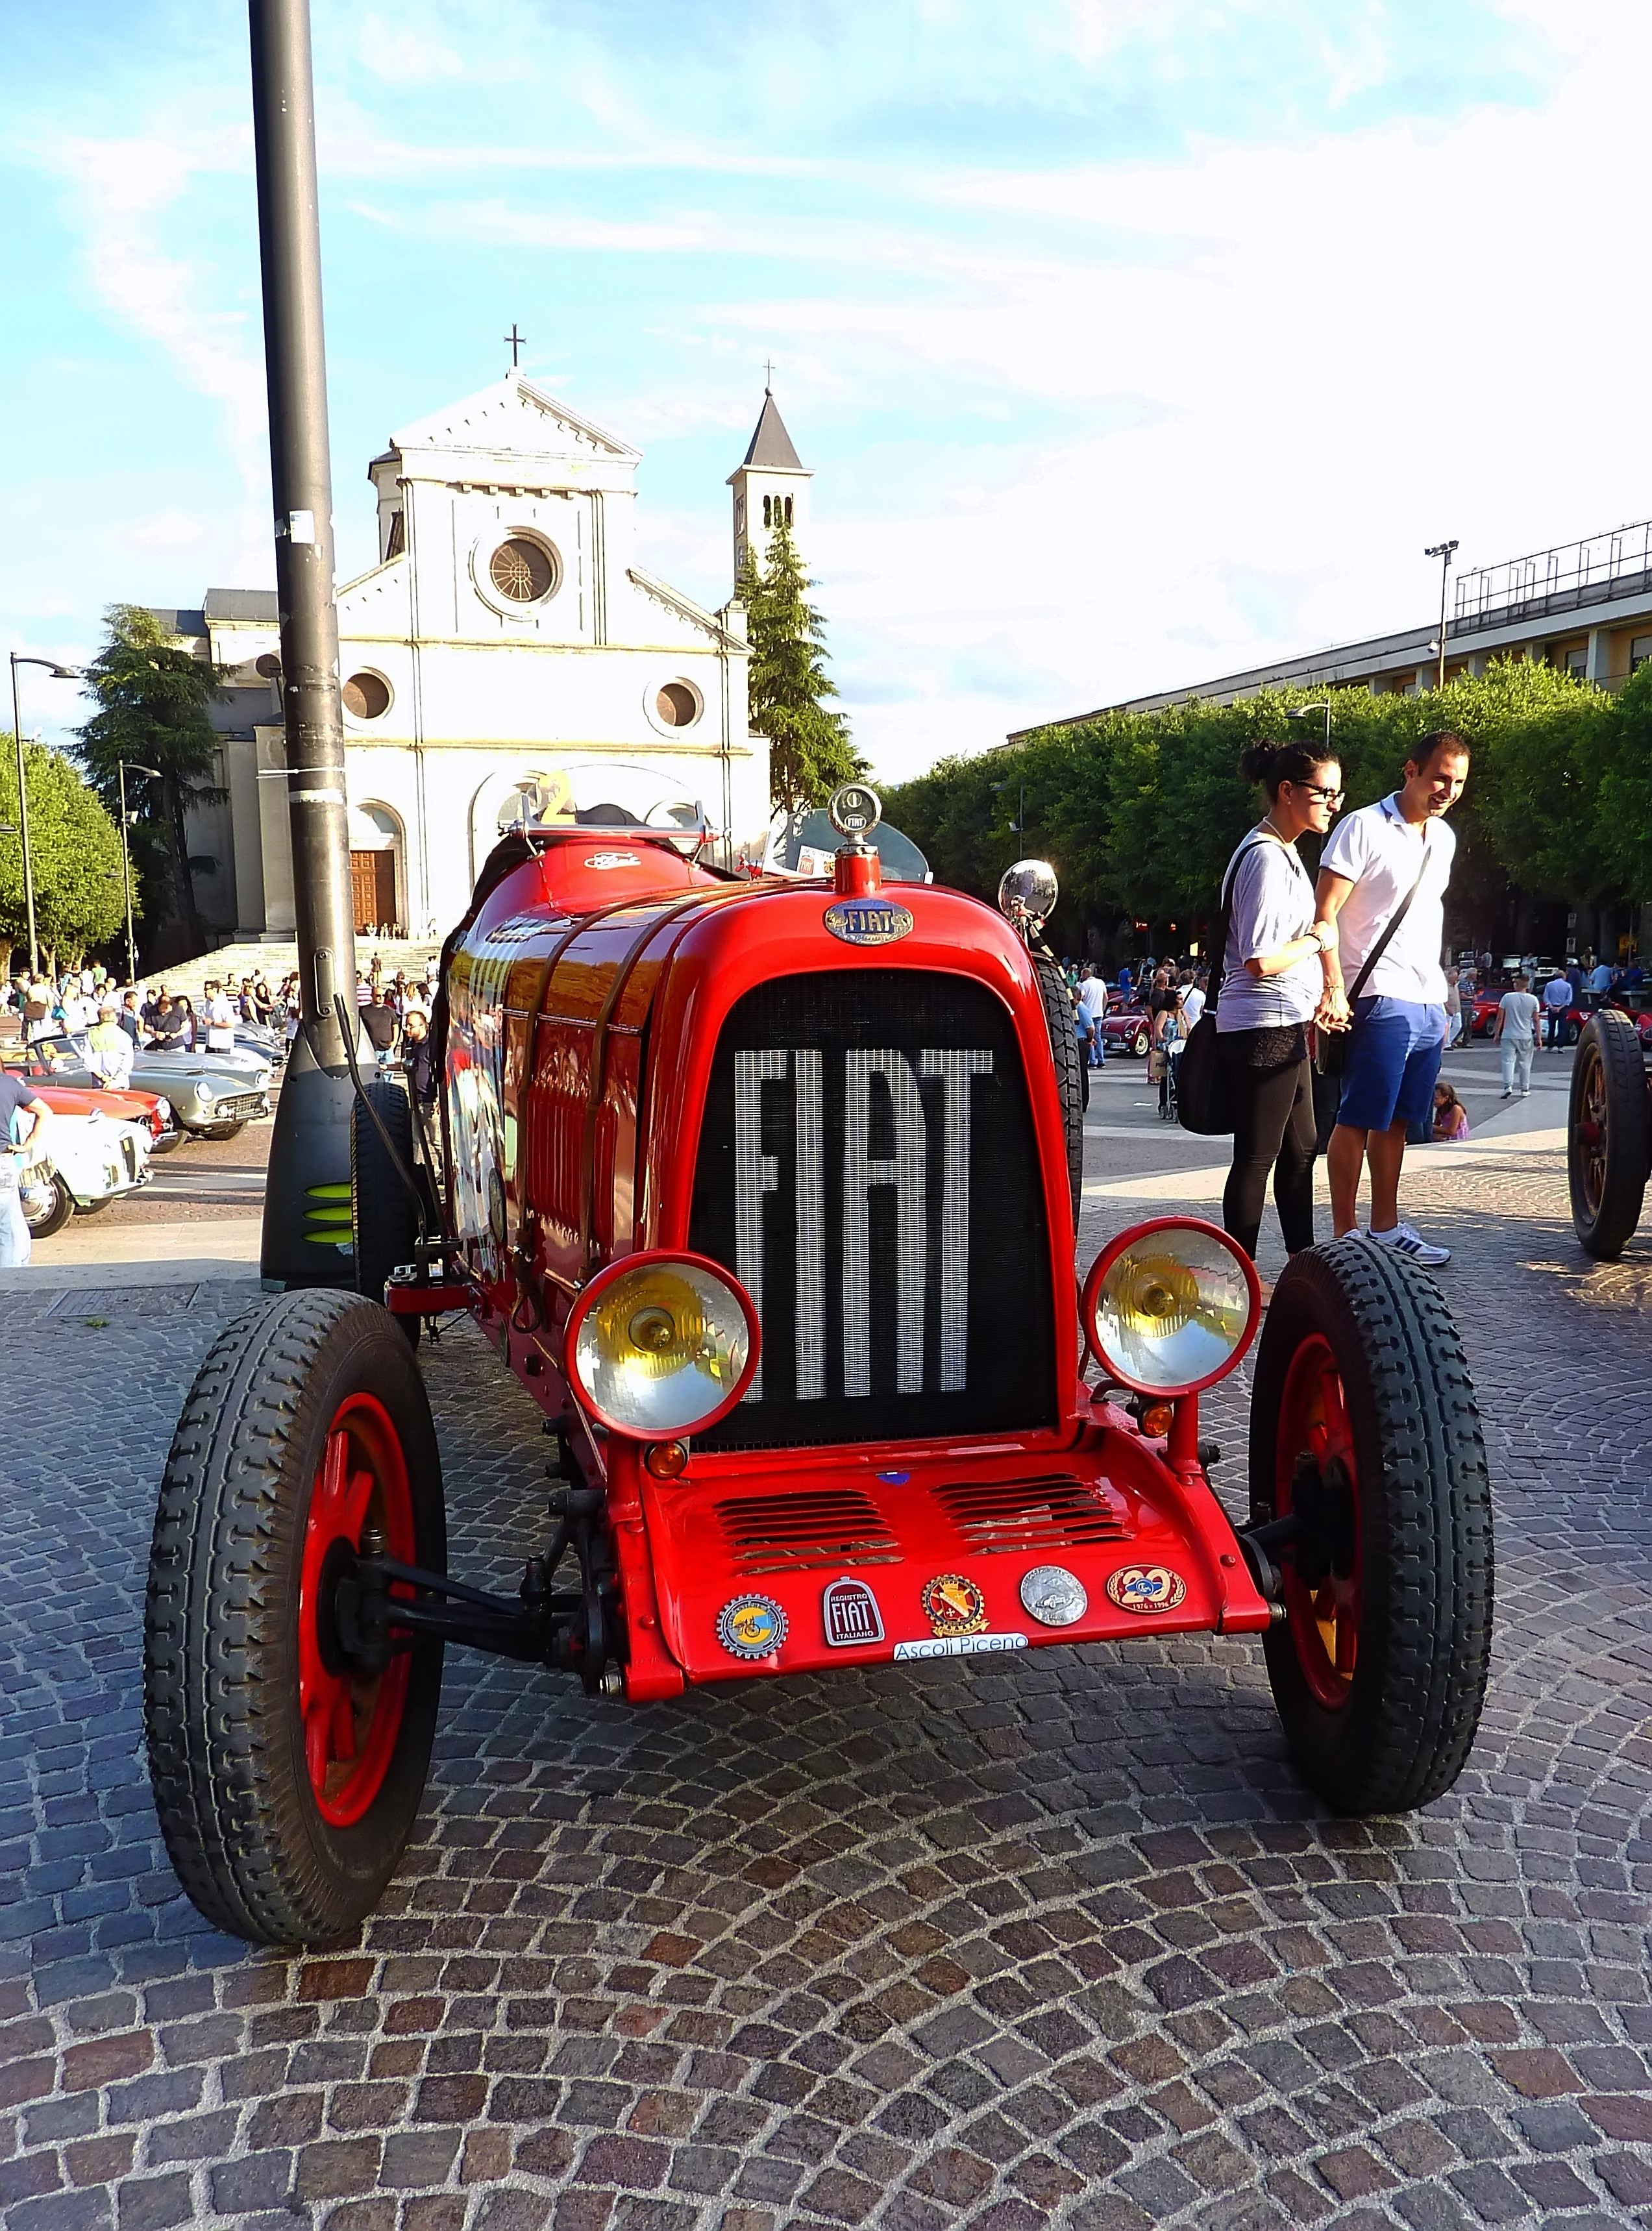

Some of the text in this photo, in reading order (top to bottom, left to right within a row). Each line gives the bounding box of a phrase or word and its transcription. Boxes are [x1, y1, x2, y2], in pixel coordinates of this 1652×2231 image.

[539, 770, 575, 825] 2
[848, 818, 863, 827] FIAT
[848, 911, 891, 931] FIAT
[735, 1050, 993, 1403] FIAT
[1122, 1568, 1170, 1603] 20
[831, 1593, 867, 1602] REGISTRO
[832, 1601, 870, 1633] FIAT
[836, 1630, 874, 1640] ITALIANO
[896, 1636, 1027, 1659] Ascoli Piceno
